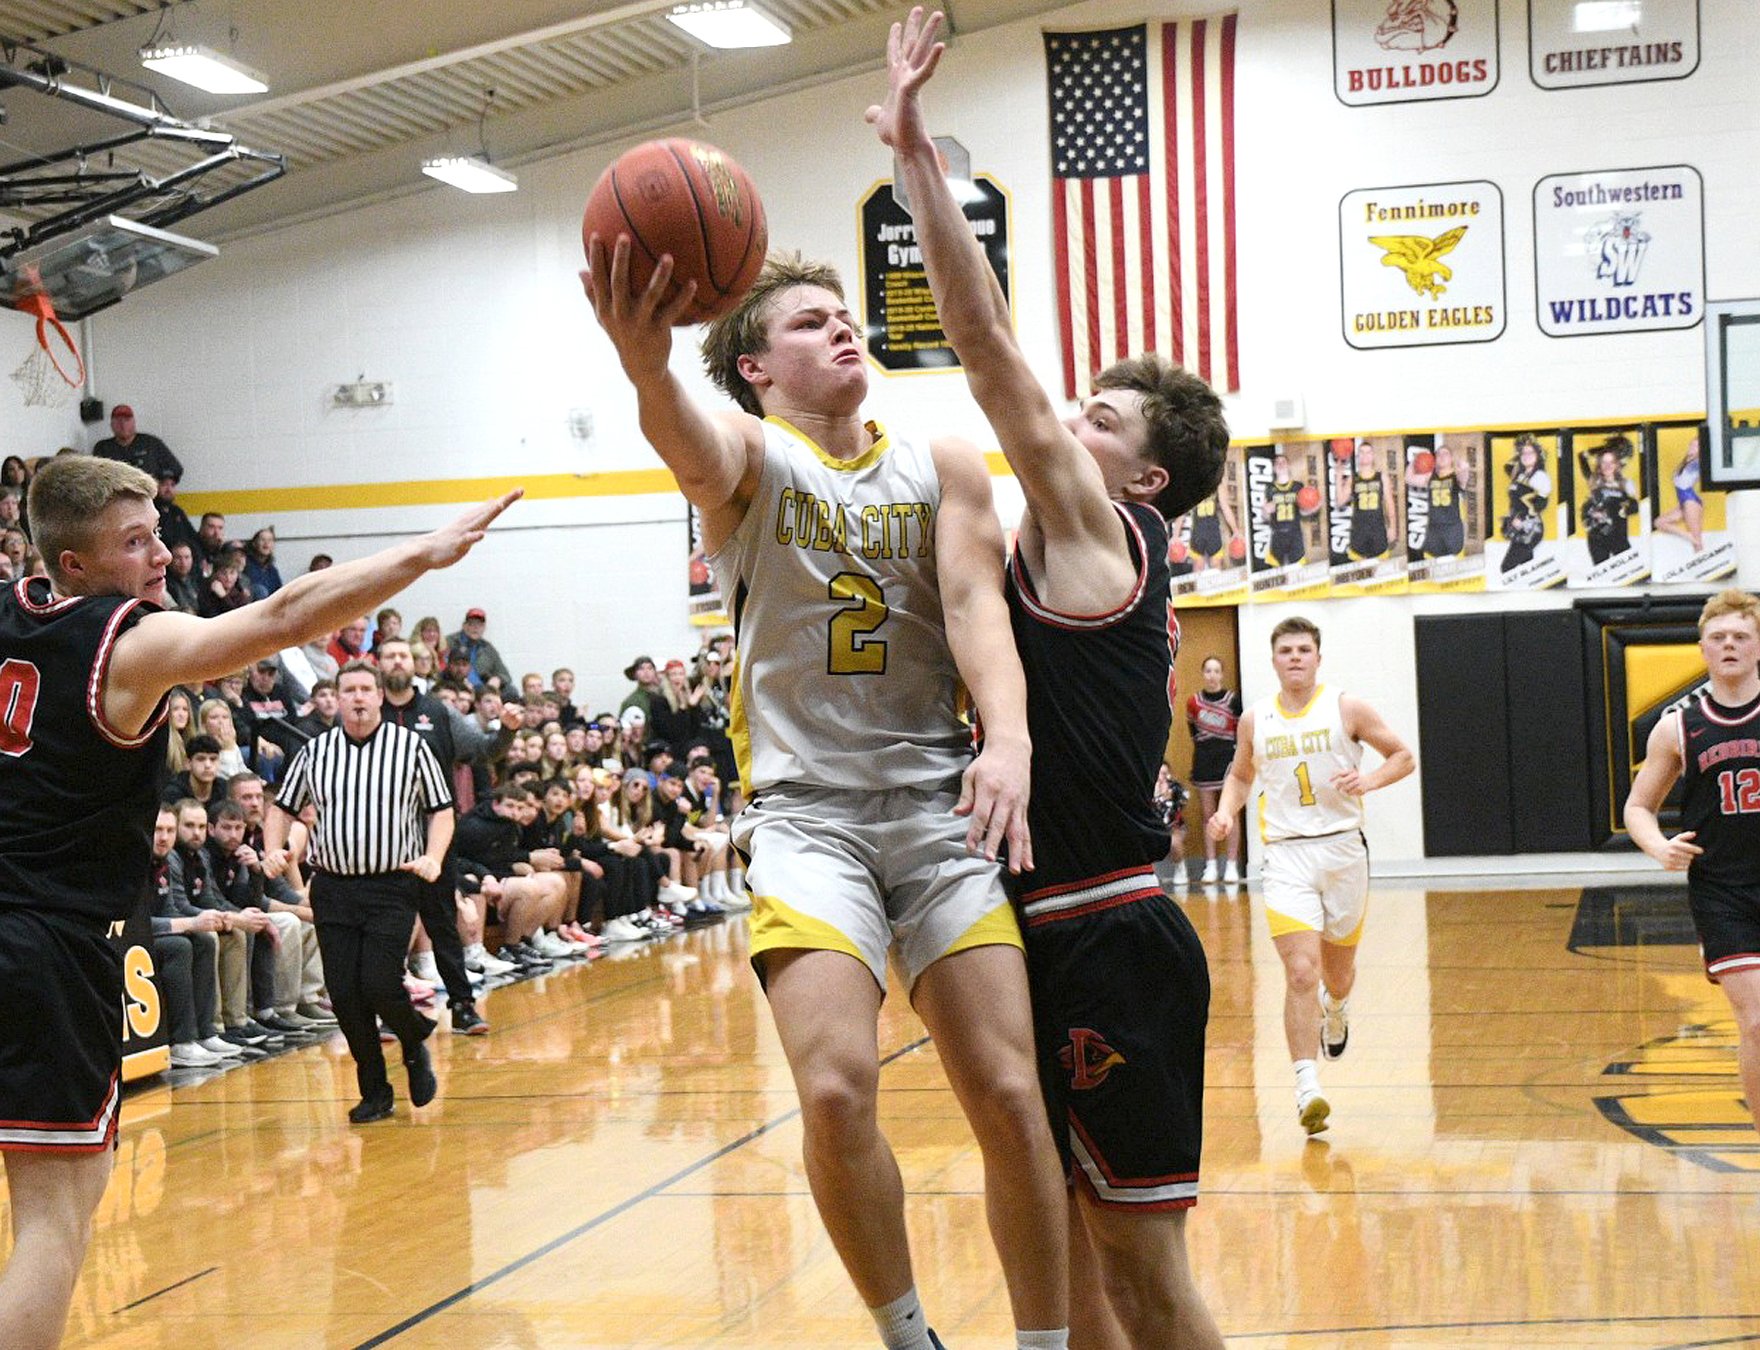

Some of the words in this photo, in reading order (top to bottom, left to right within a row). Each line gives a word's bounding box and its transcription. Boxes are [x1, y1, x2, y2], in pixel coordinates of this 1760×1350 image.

[1544, 42, 1683, 74] CHIEFTAINS
[1348, 59, 1488, 92] BULLDOGS
[1366, 199, 1480, 222] Fennimore
[1553, 182, 1683, 208] Southwestern
[1355, 310, 1420, 332] GOLDEN
[1428, 305, 1493, 328] EAGLES
[1550, 293, 1692, 324] WILDCATS
[776, 487, 850, 555] CUBA
[861, 502, 932, 559] CITY
[827, 572, 889, 675] 2
[1265, 735, 1299, 760] CUBA
[1302, 728, 1332, 754] CITY
[1293, 761, 1317, 807] 1
[1718, 768, 1760, 815] 12
